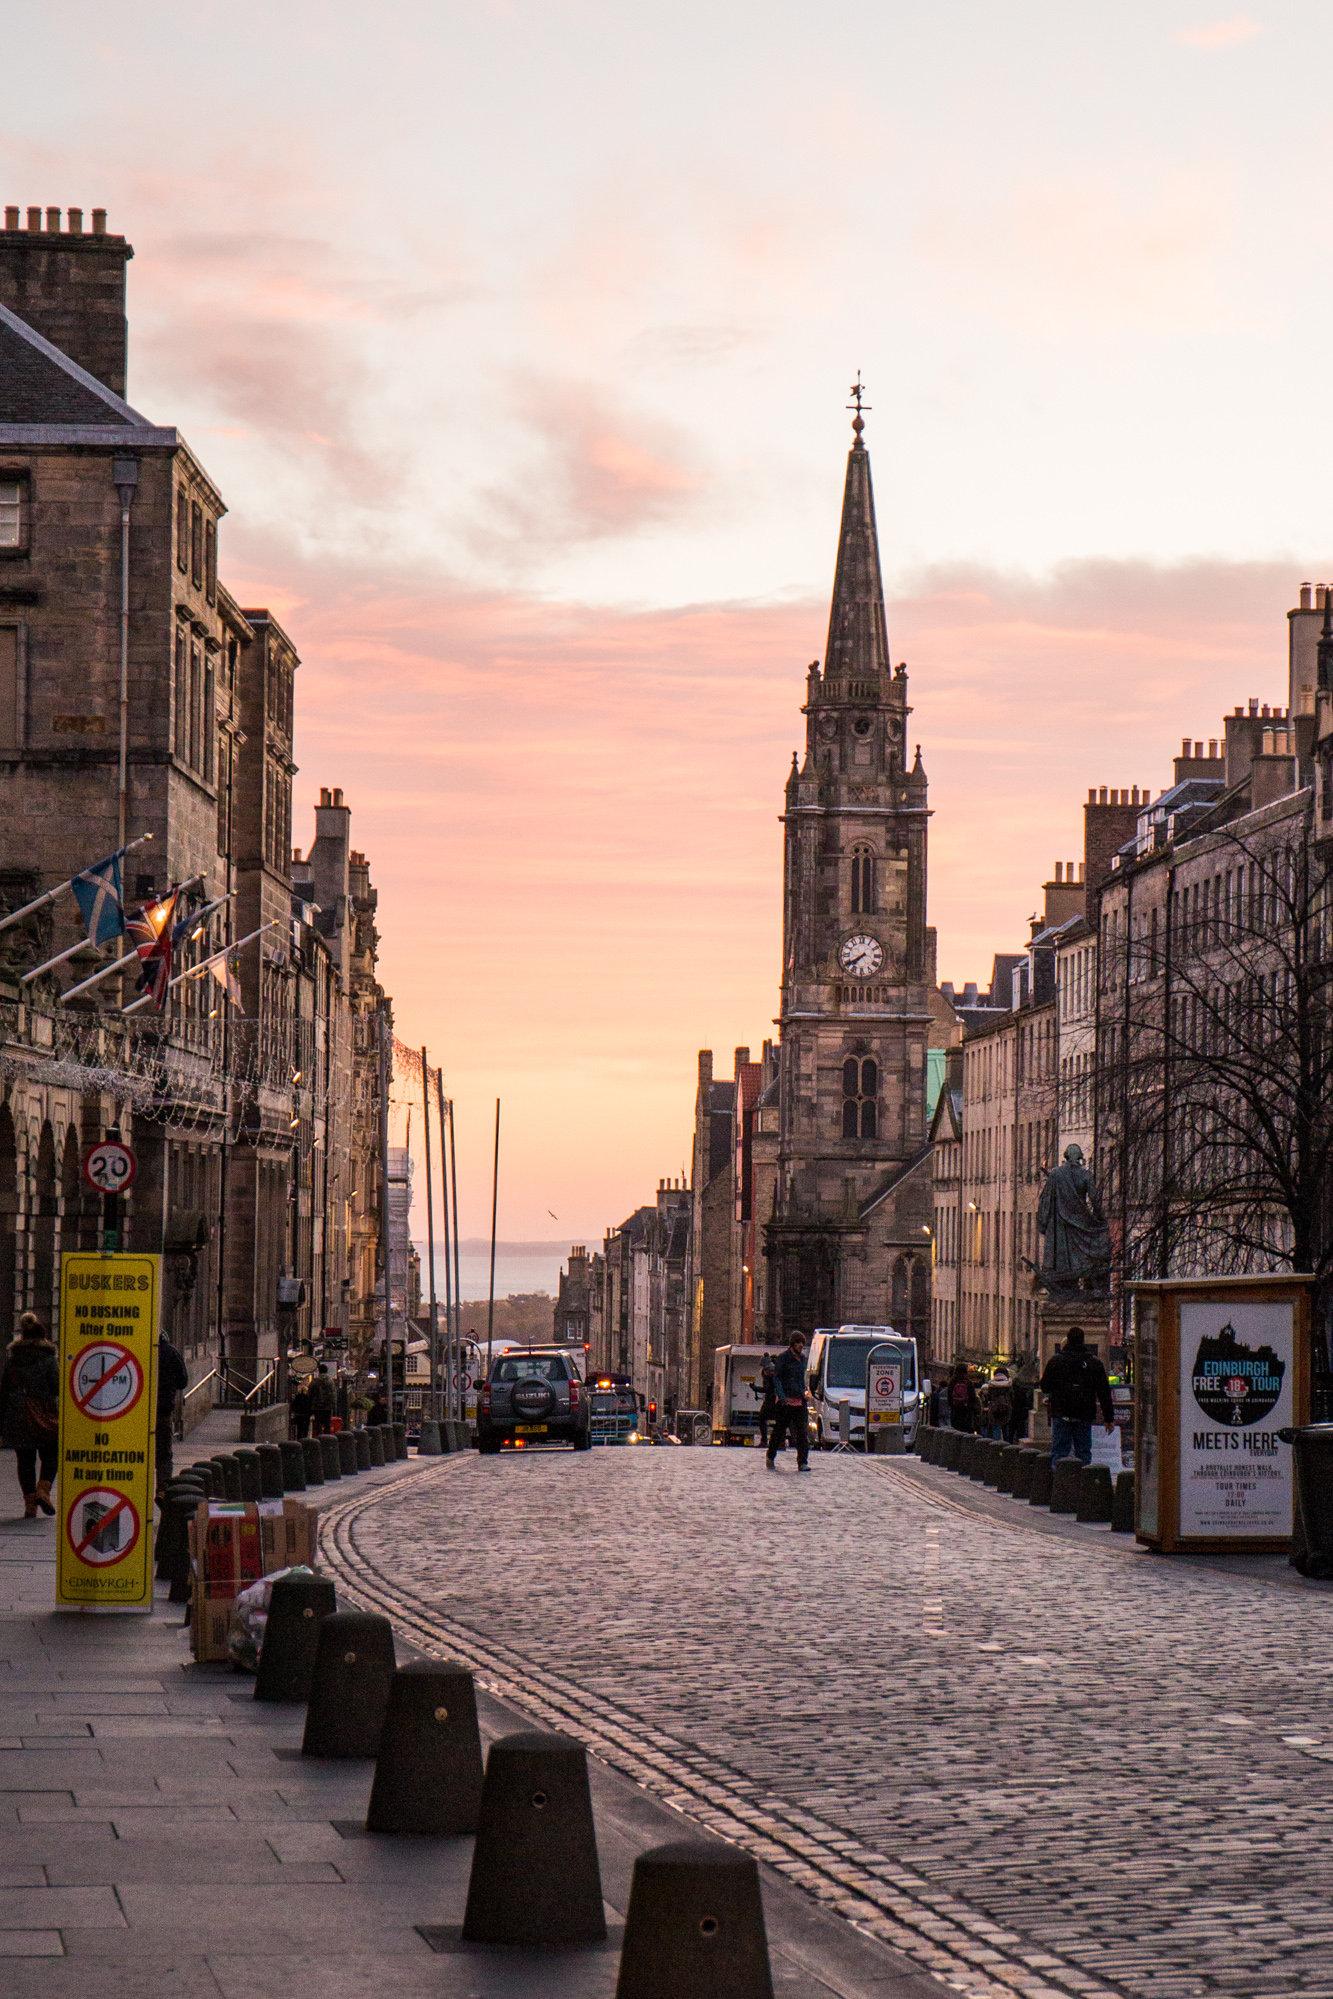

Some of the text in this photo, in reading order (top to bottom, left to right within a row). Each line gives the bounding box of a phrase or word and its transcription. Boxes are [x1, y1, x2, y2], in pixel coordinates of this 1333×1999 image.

[92, 1155, 128, 1177] 20
[68, 1274, 149, 1291] BUSKERS
[75, 1305, 140, 1319] NO BUSKING
[80, 1323, 134, 1337] After 9pm
[1204, 1360, 1269, 1376] EDINBURGH
[81, 1374, 88, 1385] 9
[112, 1375, 127, 1384] PM
[1193, 1376, 1221, 1391] FREE
[1251, 1376, 1280, 1391] TOUR
[515, 1392, 550, 1400] SUZUKI
[94, 1432, 109, 1446] NO
[1193, 1432, 1279, 1450] MEETS HERE
[65, 1450, 144, 1463] AMPLIFICATION
[1249, 1449, 1278, 1457] EVERYDAY
[73, 1467, 134, 1482] At any time
[1216, 1482, 1257, 1490] TOUR TIMES
[1225, 1499, 1246, 1507] DAILY
